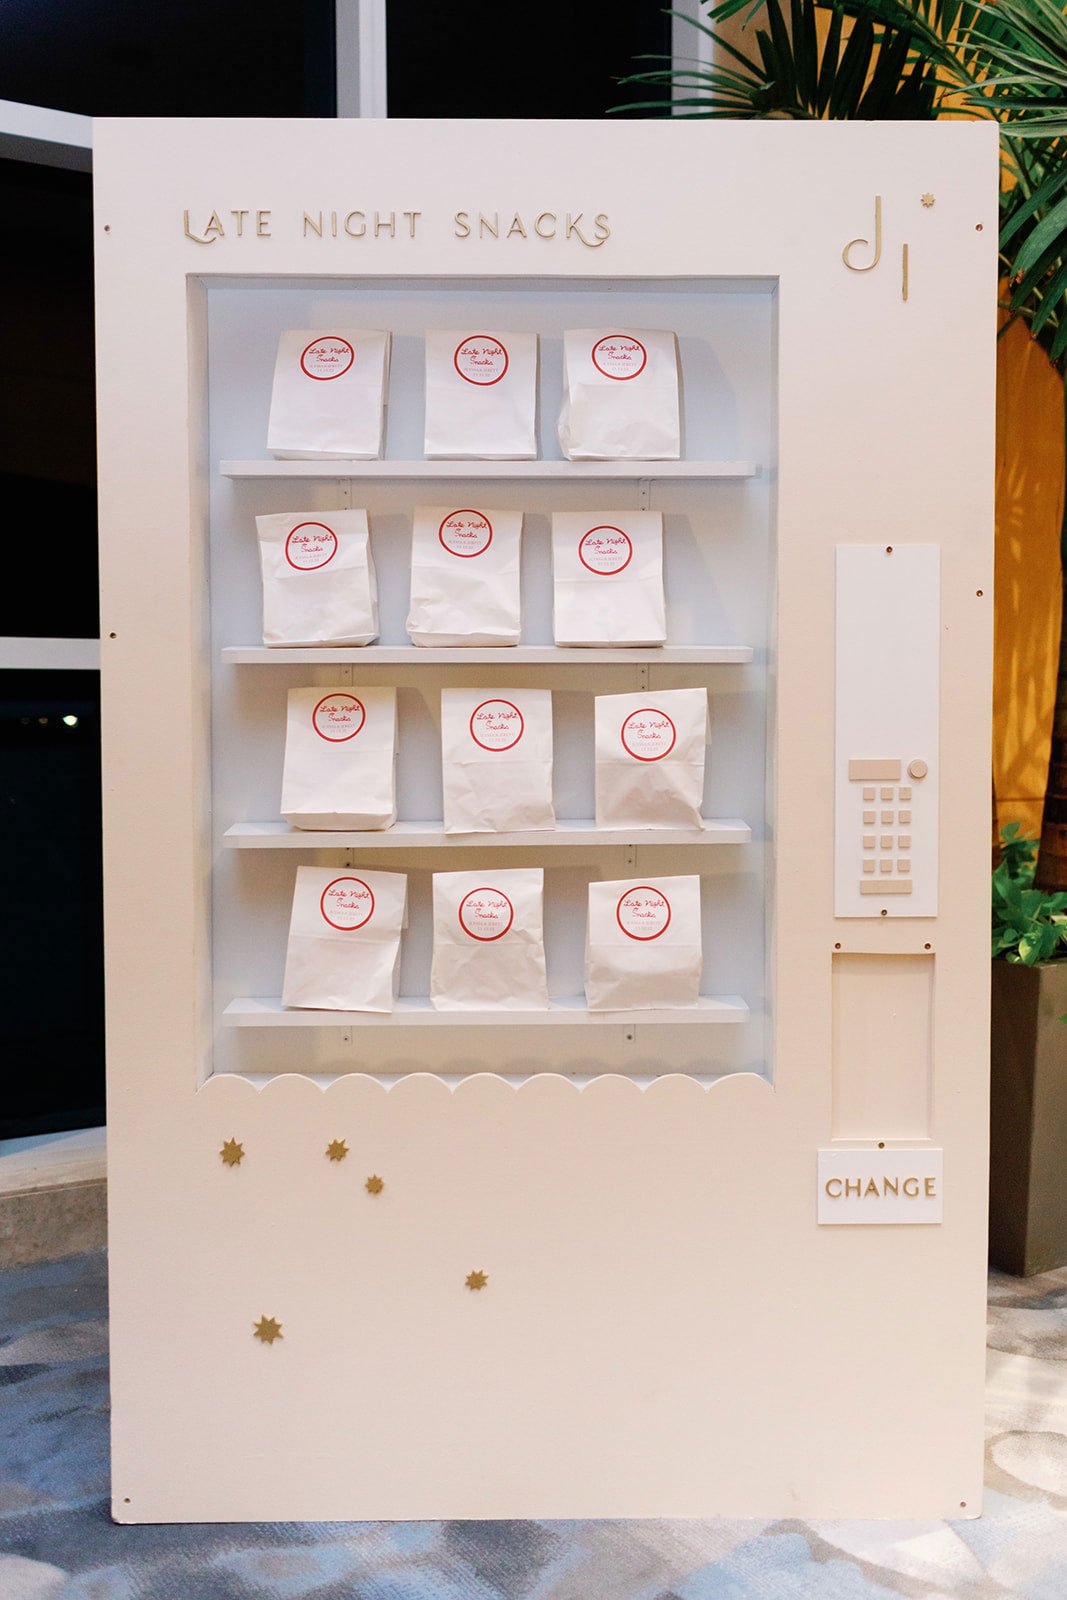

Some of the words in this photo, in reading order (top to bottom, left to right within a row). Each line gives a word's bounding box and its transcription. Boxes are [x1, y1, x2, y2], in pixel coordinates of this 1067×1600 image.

[183, 209, 272, 245] LATE
[303, 211, 422, 238] NIGHT
[454, 211, 612, 248] SNACKS
[461, 348, 479, 356] Late
[598, 345, 616, 353] Late
[470, 356, 493, 365] Snacks
[608, 352, 631, 360] Snacks
[446, 521, 465, 529] Late
[454, 528, 478, 538] Snacks
[301, 544, 323, 552] Snacks
[594, 546, 618, 554] Snacks
[320, 705, 338, 713] Late
[328, 713, 351, 722] Snacks
[486, 720, 509, 730] Snacks
[628, 722, 646, 730] Late
[637, 730, 661, 739] Snacks
[328, 889, 346, 897] Late
[350, 890, 369, 899] Night
[336, 898, 360, 909] Snacks
[488, 900, 507, 908] Night
[474, 908, 498, 918] Snacks
[632, 908, 656, 918] Snacks
[825, 1176, 937, 1198] CHANGE
